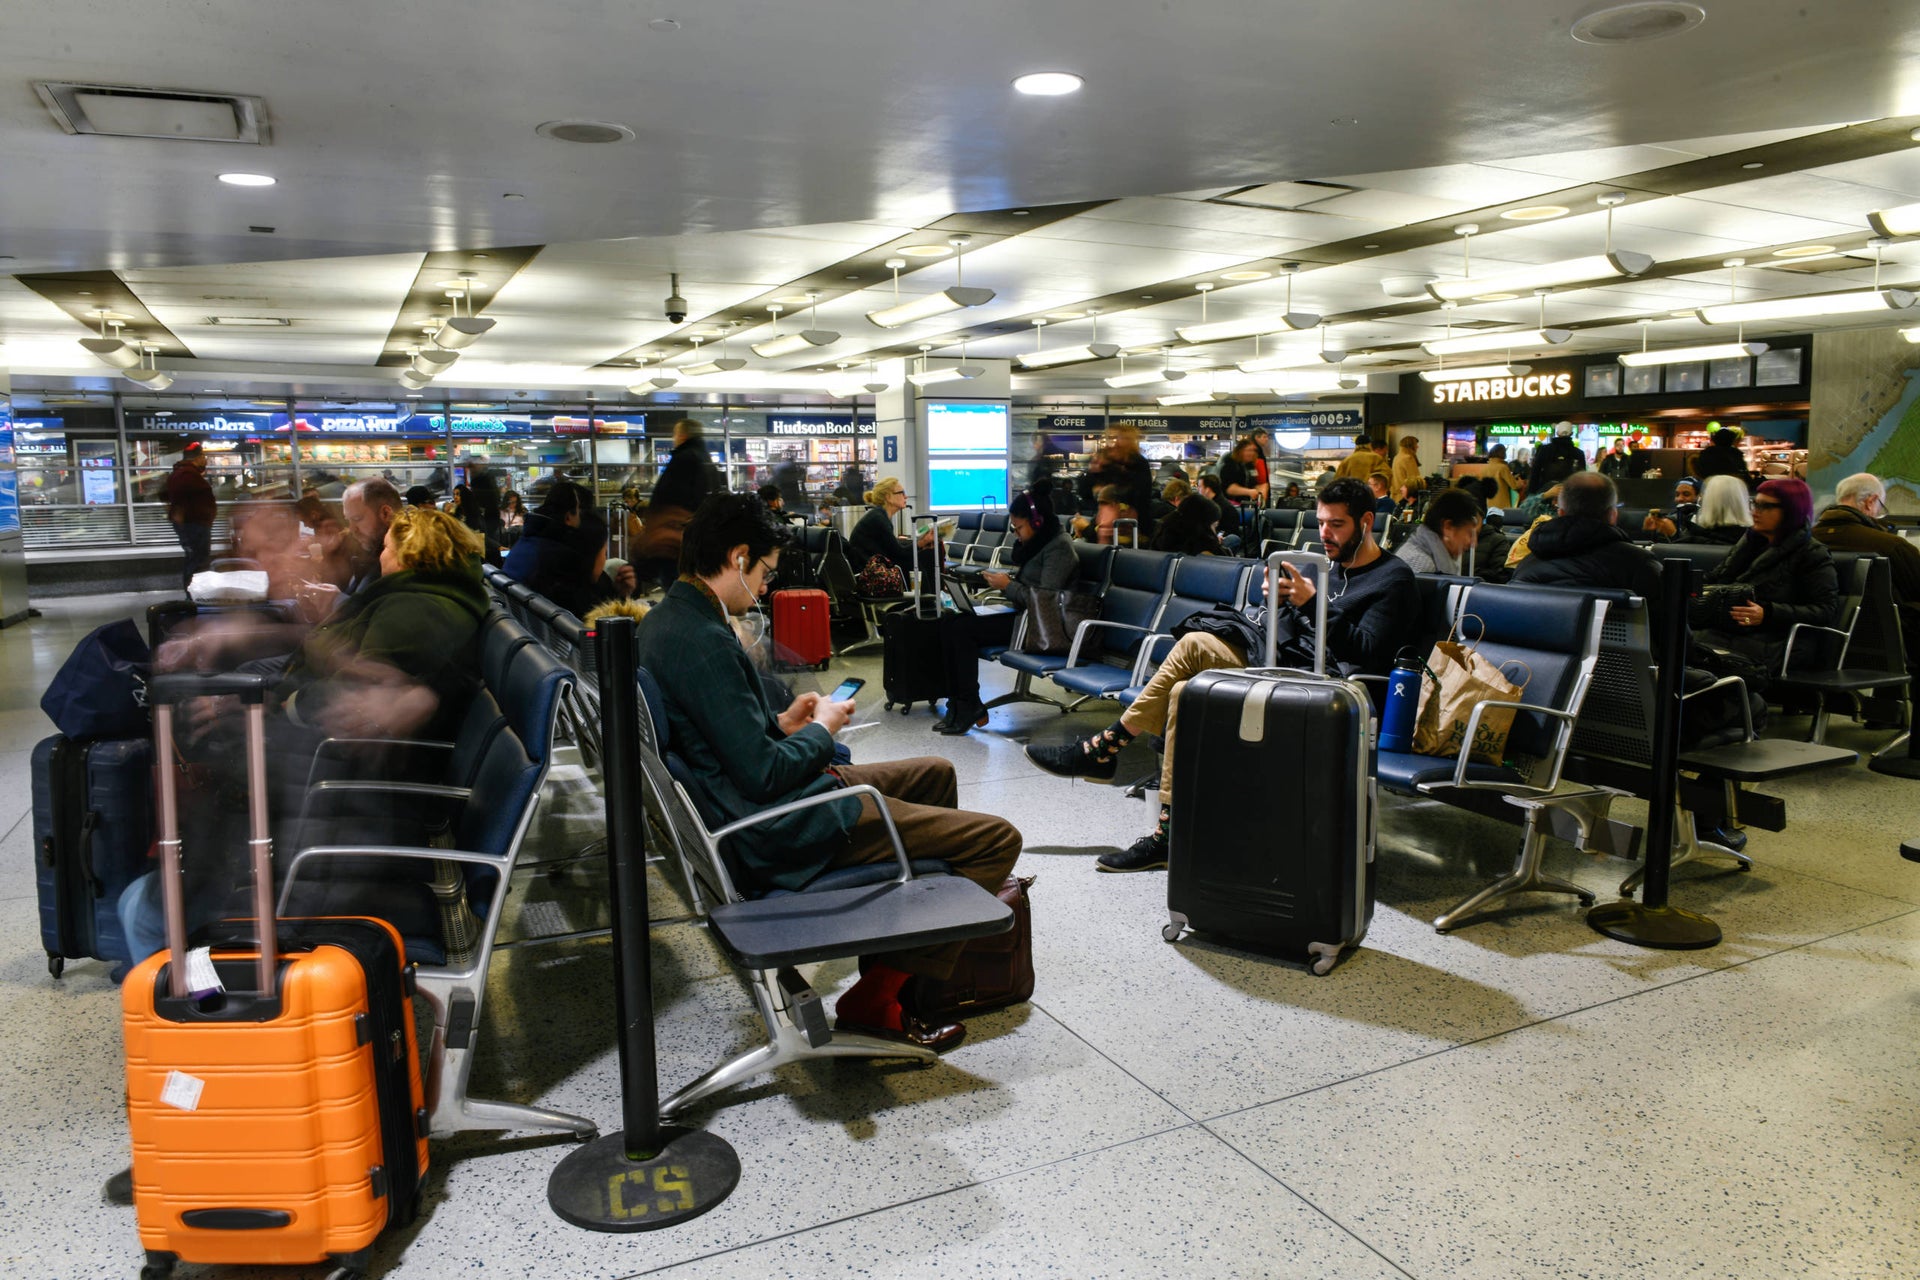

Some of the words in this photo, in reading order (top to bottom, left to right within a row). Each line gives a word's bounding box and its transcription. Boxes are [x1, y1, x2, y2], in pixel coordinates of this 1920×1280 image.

[1433, 373, 1572, 403] STARBUCKS
[142, 417, 255, 435] Häagen-Dazs
[321, 418, 366, 432] PIZZA
[365, 416, 398, 432] HUT
[1054, 418, 1086, 427] COFFEE
[1120, 419, 1136, 427] HOT
[1138, 419, 1168, 428] BAGELS
[1251, 417, 1283, 426] Information
[1286, 416, 1310, 424] Elevator
[1491, 424, 1521, 434] Jamba
[1529, 424, 1552, 434] Juice
[1455, 719, 1507, 743] WOLE
[608, 1166, 694, 1220] CS
